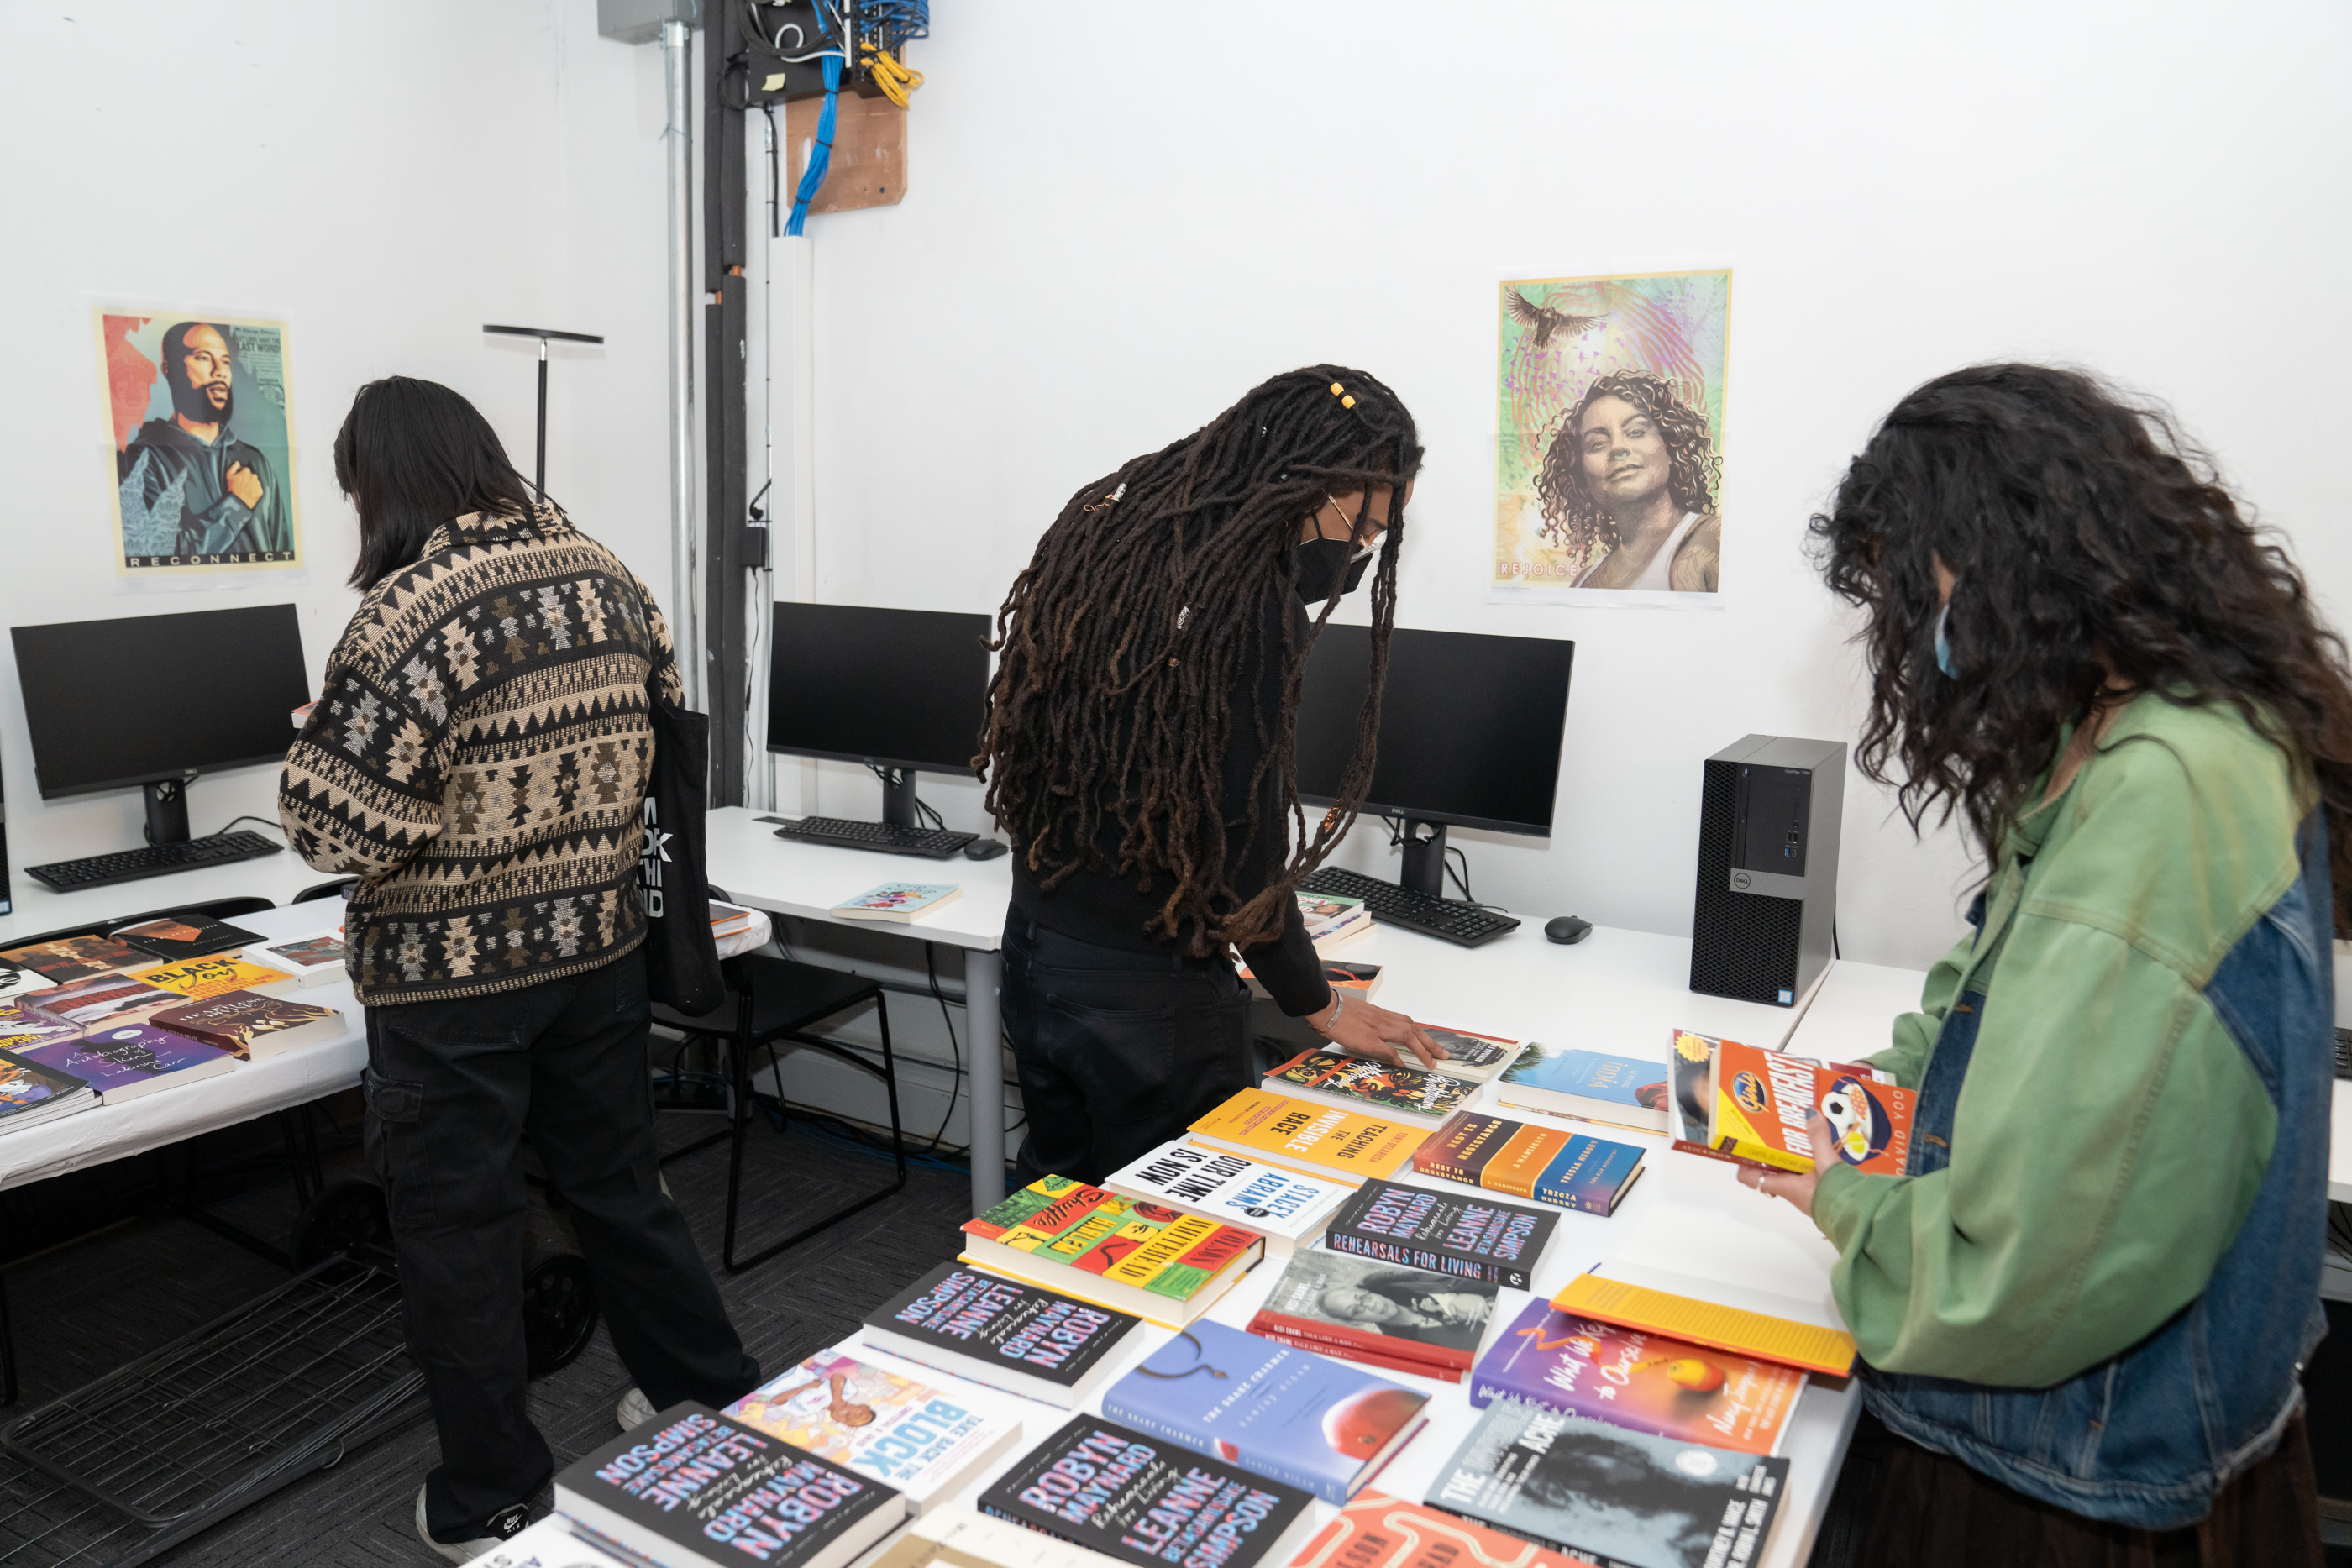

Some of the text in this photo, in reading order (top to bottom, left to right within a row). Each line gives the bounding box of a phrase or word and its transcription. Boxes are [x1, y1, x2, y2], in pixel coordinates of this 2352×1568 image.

[130, 552, 291, 567] RECONNECT
[1500, 563, 1578, 577] REJOICE
[141, 957, 239, 983] BLACK
[66, 1035, 171, 1067] Autobiography
[98, 1053, 153, 1067] Skin
[153, 1057, 186, 1070] Carr
[1326, 1060, 1383, 1089] Mothering
[1620, 1069, 1638, 1088] LEAVING
[1735, 1072, 1766, 1110] Girls
[1269, 1112, 1310, 1135] RACE
[1764, 1050, 1815, 1158] FOR BREAKFAST
[1285, 1110, 1347, 1151] INVISIBLE
[1331, 1130, 1350, 1141] THE
[1337, 1124, 1387, 1158] TEACHING
[1368, 1131, 1408, 1162] TONY DELAROSA
[1446, 1123, 1477, 1147] REST IS
[1457, 1120, 1501, 1159] RESISTANCE
[1516, 1133, 1546, 1162] MANIFESTO
[1892, 1090, 1910, 1176] DAVID YOO
[1136, 1147, 1207, 1185] IS NOW
[1420, 1167, 1474, 1184] RESISTANCE
[1430, 1162, 1451, 1171] REST
[1560, 1162, 1582, 1183] TRICIA
[1578, 1140, 1598, 1161] HERSEY
[1747, 1148, 1776, 1162] GIRLS
[1777, 1157, 1798, 1167] FOR
[1165, 1155, 1251, 1202] OUR TIME
[1226, 1172, 1289, 1211] ABRAMS
[1494, 1182, 1528, 1193] MANIFESTO
[1542, 1188, 1577, 1201] TRICIA
[1024, 1188, 1104, 1225] Shuffle
[1259, 1184, 1319, 1218] STACEY
[1357, 1188, 1414, 1233] ROBYN
[1389, 1193, 1436, 1238] MAYNARD
[1415, 1202, 1447, 1240] Rehearsals
[1541, 1195, 1577, 1209] HERSEY
[1047, 1216, 1116, 1254] HARLEM
[1431, 1205, 1460, 1239] for Living
[1443, 1204, 1494, 1251] LEANNE
[1474, 1210, 1510, 1254] BETASAMOSAKE
[1493, 1214, 1536, 1260] SIMPSON
[1120, 1219, 1211, 1277] WHITEHEAD
[1190, 1229, 1251, 1261] COLSON
[1333, 1233, 1482, 1279] REHEARSALS FOR LIVING
[895, 1272, 974, 1323] SIMPSON
[921, 1279, 992, 1329] BETASAMOSAKE
[939, 1284, 1021, 1339] LEANNE
[1283, 1282, 1311, 1311] NISI SHAWL
[978, 1298, 1030, 1338] for Living
[990, 1298, 1048, 1344] Rehearsals
[1000, 1301, 1075, 1357] MAYNARD
[1025, 1308, 1109, 1367] ROBYN
[1273, 1324, 1284, 1333] NISI
[1286, 1326, 1302, 1337] SHAWL
[1303, 1331, 1317, 1340] TALK
[1277, 1335, 1293, 1346] SHAWL
[1294, 1340, 1308, 1349] TALK
[1310, 1343, 1323, 1351] LIKE
[1330, 1348, 1342, 1356] MAN
[1544, 1319, 1619, 1391] What We Kep
[1593, 1329, 1655, 1399] to Ourselve
[1202, 1406, 1221, 1423] THE
[1221, 1382, 1250, 1406] SNAKE
[1250, 1349, 1289, 1382] CHARMER
[1478, 1384, 1506, 1399] What
[1525, 1394, 1550, 1410] Kept
[1107, 1403, 1124, 1416] THE
[1127, 1412, 1156, 1429] SNAKE
[1160, 1424, 1205, 1448] CHARMER
[1513, 1412, 1569, 1454] ACHE
[1706, 1392, 1748, 1435] Nancy
[596, 1414, 715, 1483] SIMPSON
[843, 1400, 970, 1475] BLOCK
[895, 1416, 983, 1480] TAKE BACK THE
[623, 1426, 733, 1493] BETASAMOSAKE
[641, 1434, 765, 1509] LEANNE
[1021, 1432, 1127, 1511] ROBYN
[673, 1454, 768, 1508] for Living
[698, 1455, 792, 1518] Rehearsals
[705, 1461, 830, 1540] MAYNARD
[1057, 1445, 1154, 1523] MAYNARD
[1091, 1460, 1164, 1528] Rehearsals
[1107, 1468, 1190, 1526] for Living
[1435, 1467, 1490, 1507] THE
[507, 1513, 518, 1524] NIKE
[507, 1523, 520, 1533] AIR
[724, 1472, 859, 1558] ROBYN
[1122, 1468, 1225, 1553] LEANNE
[1155, 1481, 1246, 1561] BETASAMOSAKE
[1184, 1490, 1278, 1568] SIMPSON
[1744, 1497, 1771, 1527] SMITH
